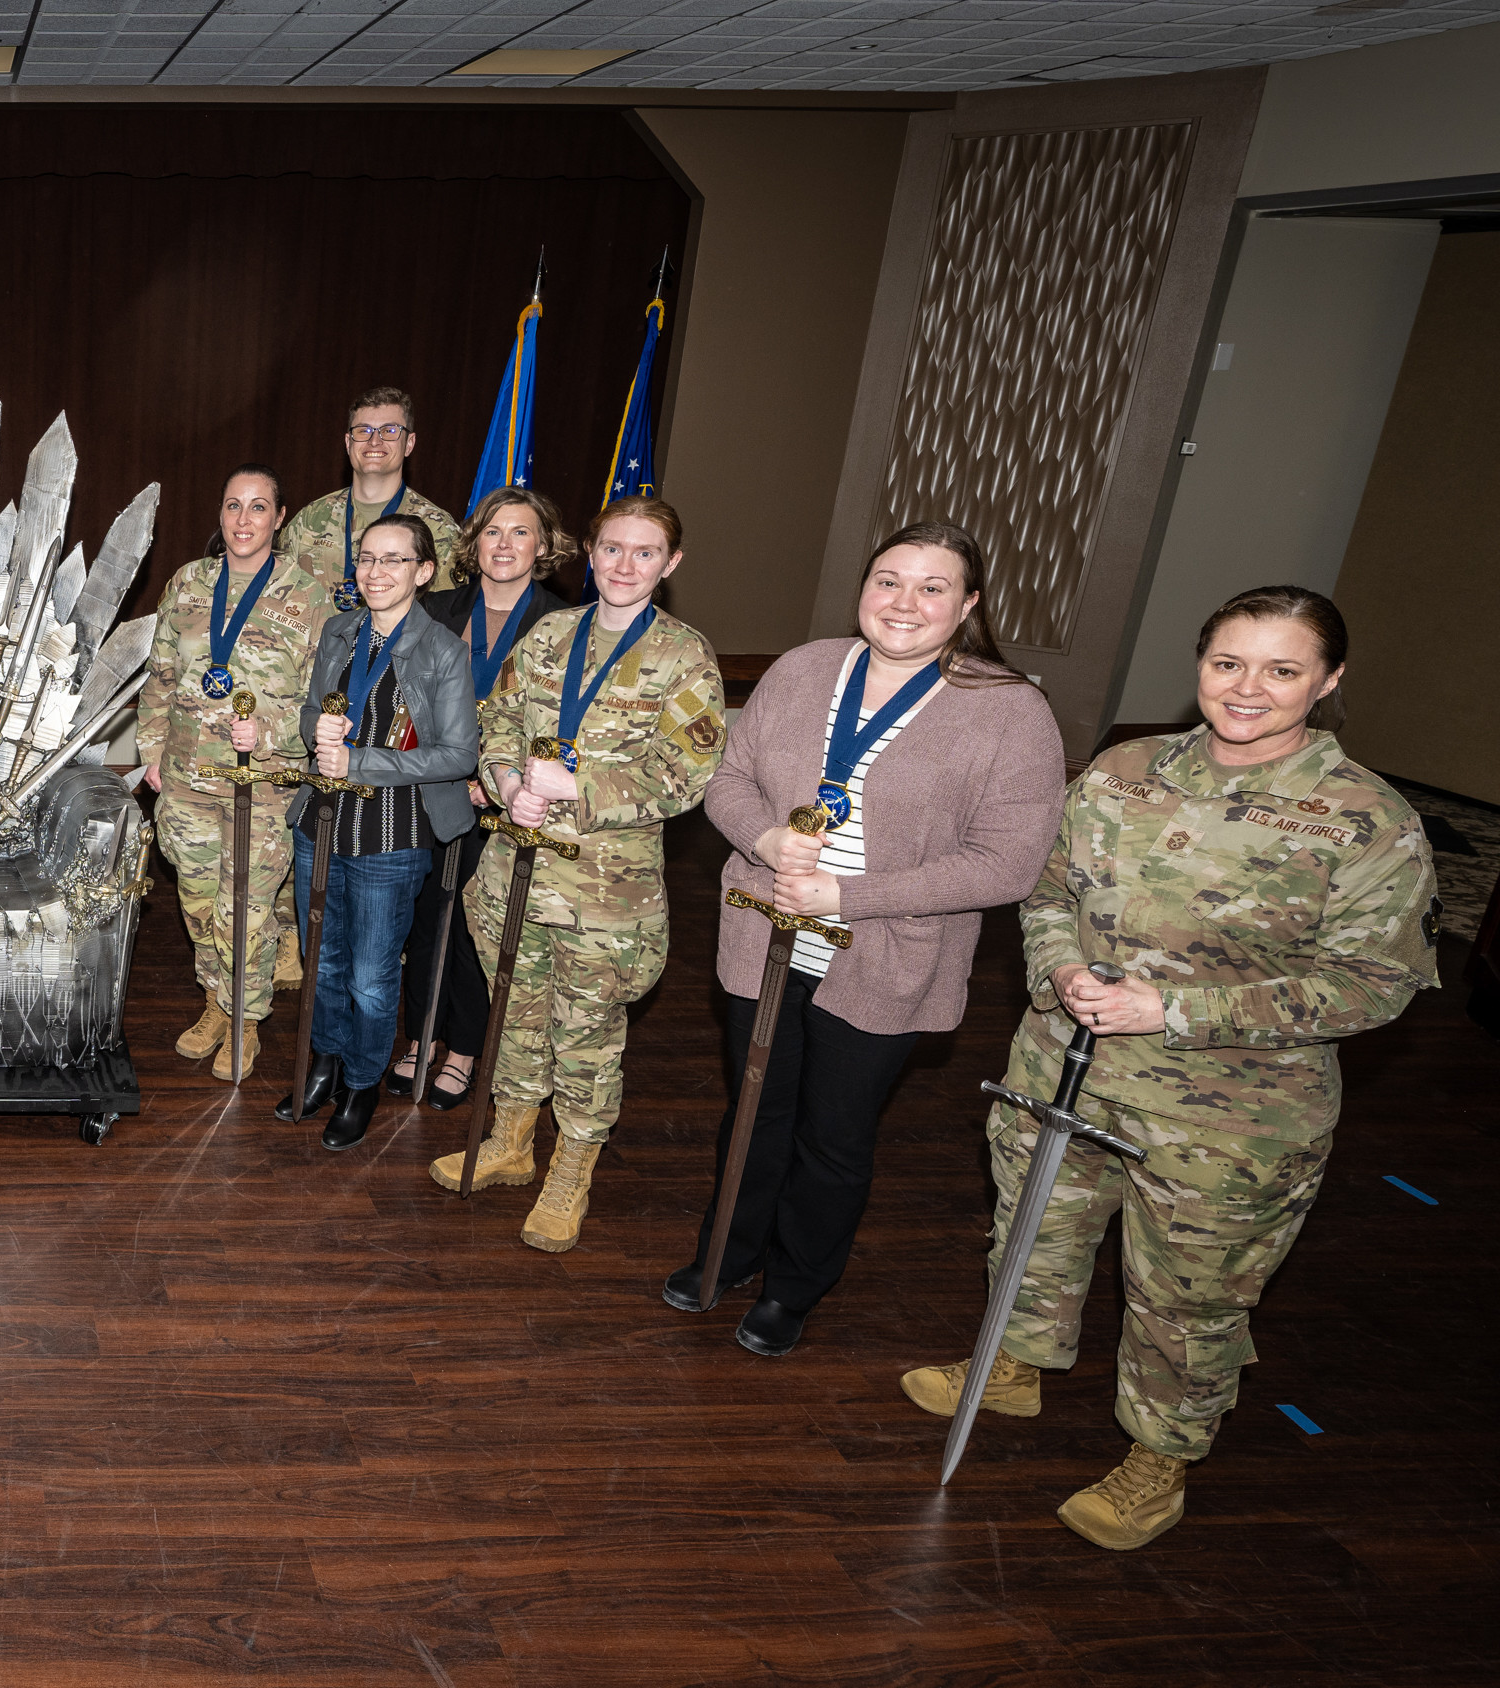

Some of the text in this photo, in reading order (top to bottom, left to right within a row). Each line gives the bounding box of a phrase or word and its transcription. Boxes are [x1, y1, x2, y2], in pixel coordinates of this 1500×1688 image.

[189, 596, 208, 605] SMITH
[263, 608, 310, 634] U.S. AIR FORCE
[1246, 808, 1352, 845] U.S. AIR FORCE
